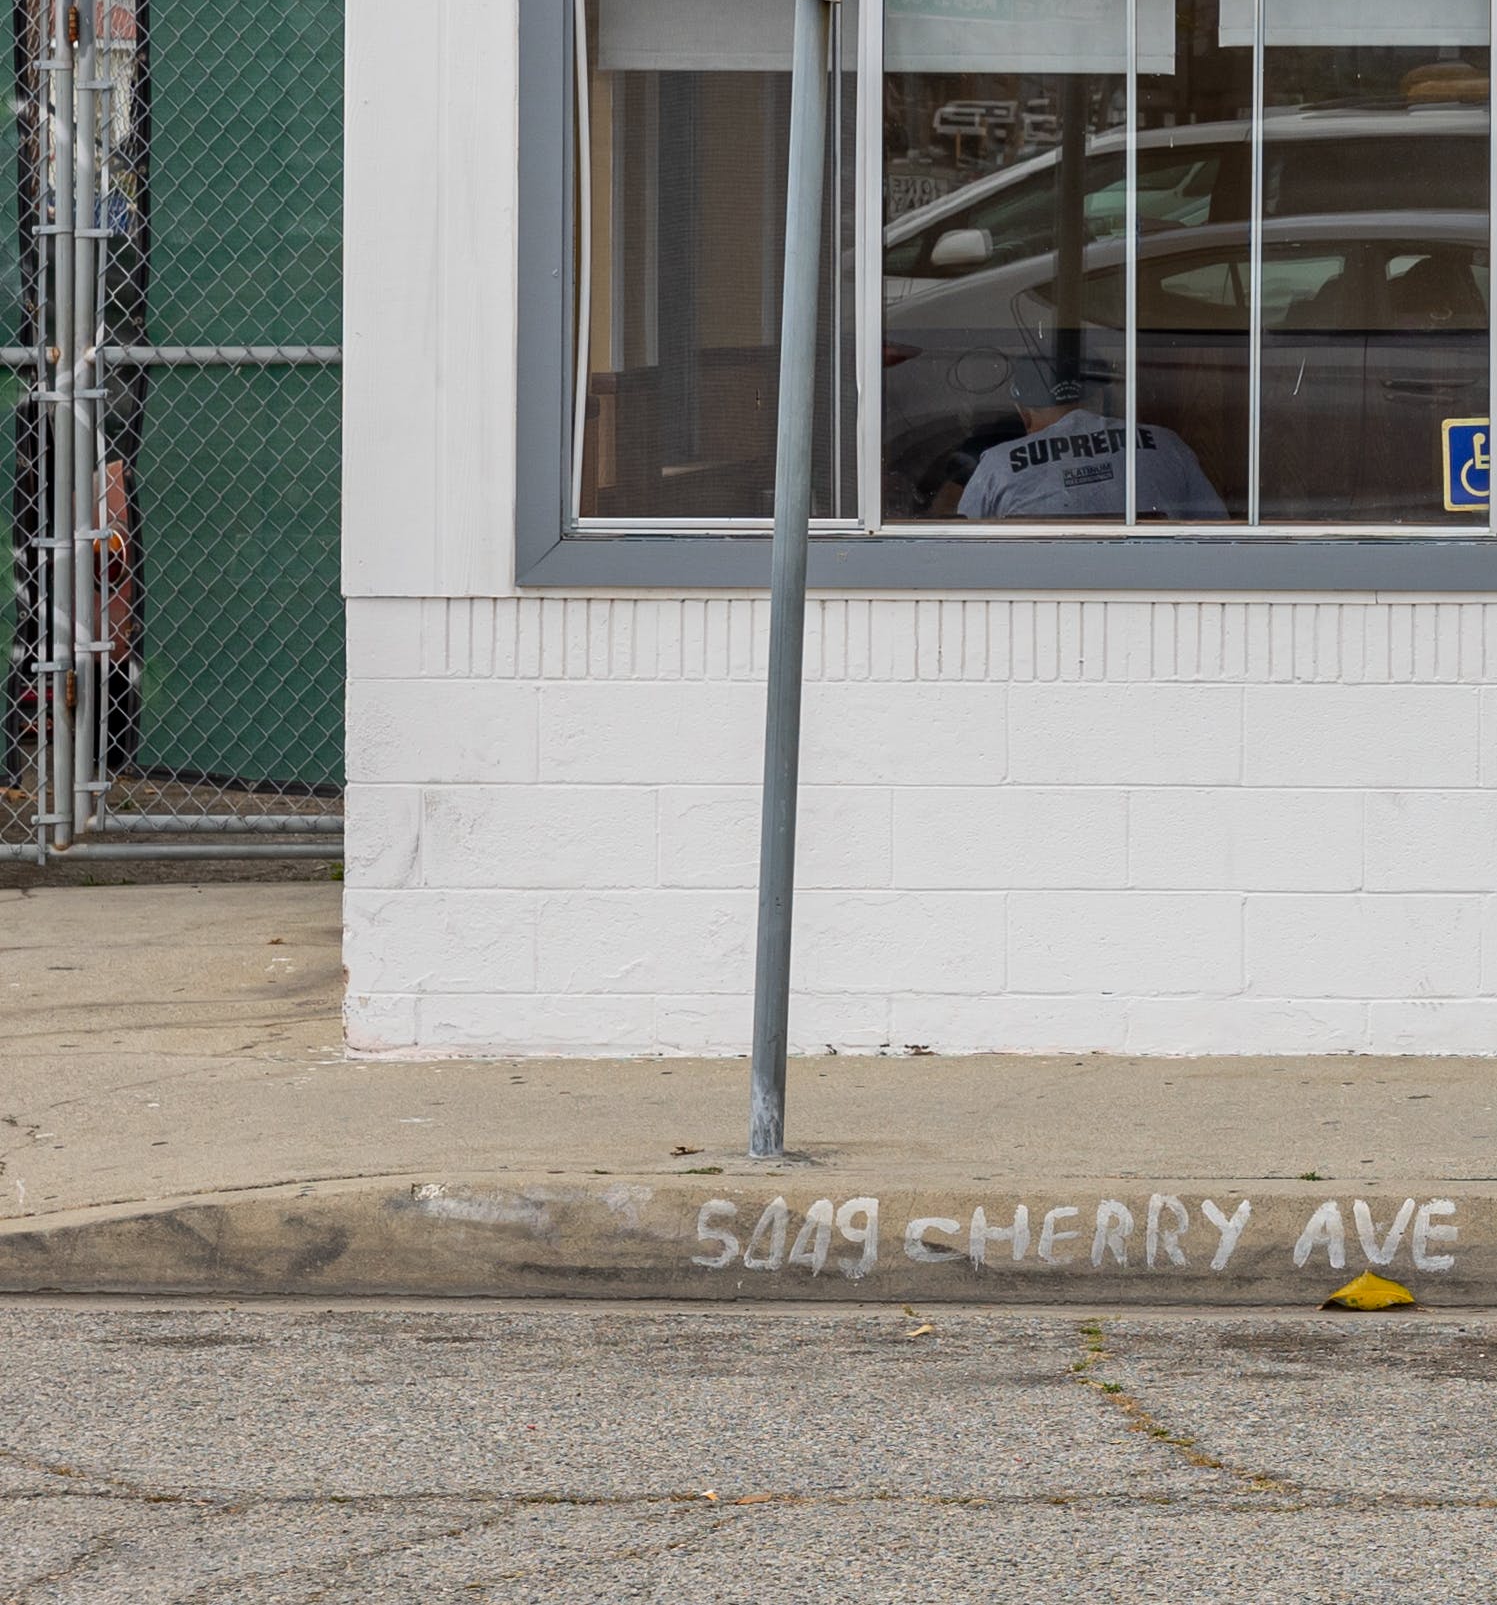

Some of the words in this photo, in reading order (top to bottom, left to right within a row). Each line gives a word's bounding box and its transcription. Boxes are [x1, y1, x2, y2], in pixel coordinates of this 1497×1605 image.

[1009, 428, 1157, 473] SUPREME
[904, 1193, 1252, 1272] CHERRY
[1293, 1197, 1459, 1272] AVE
